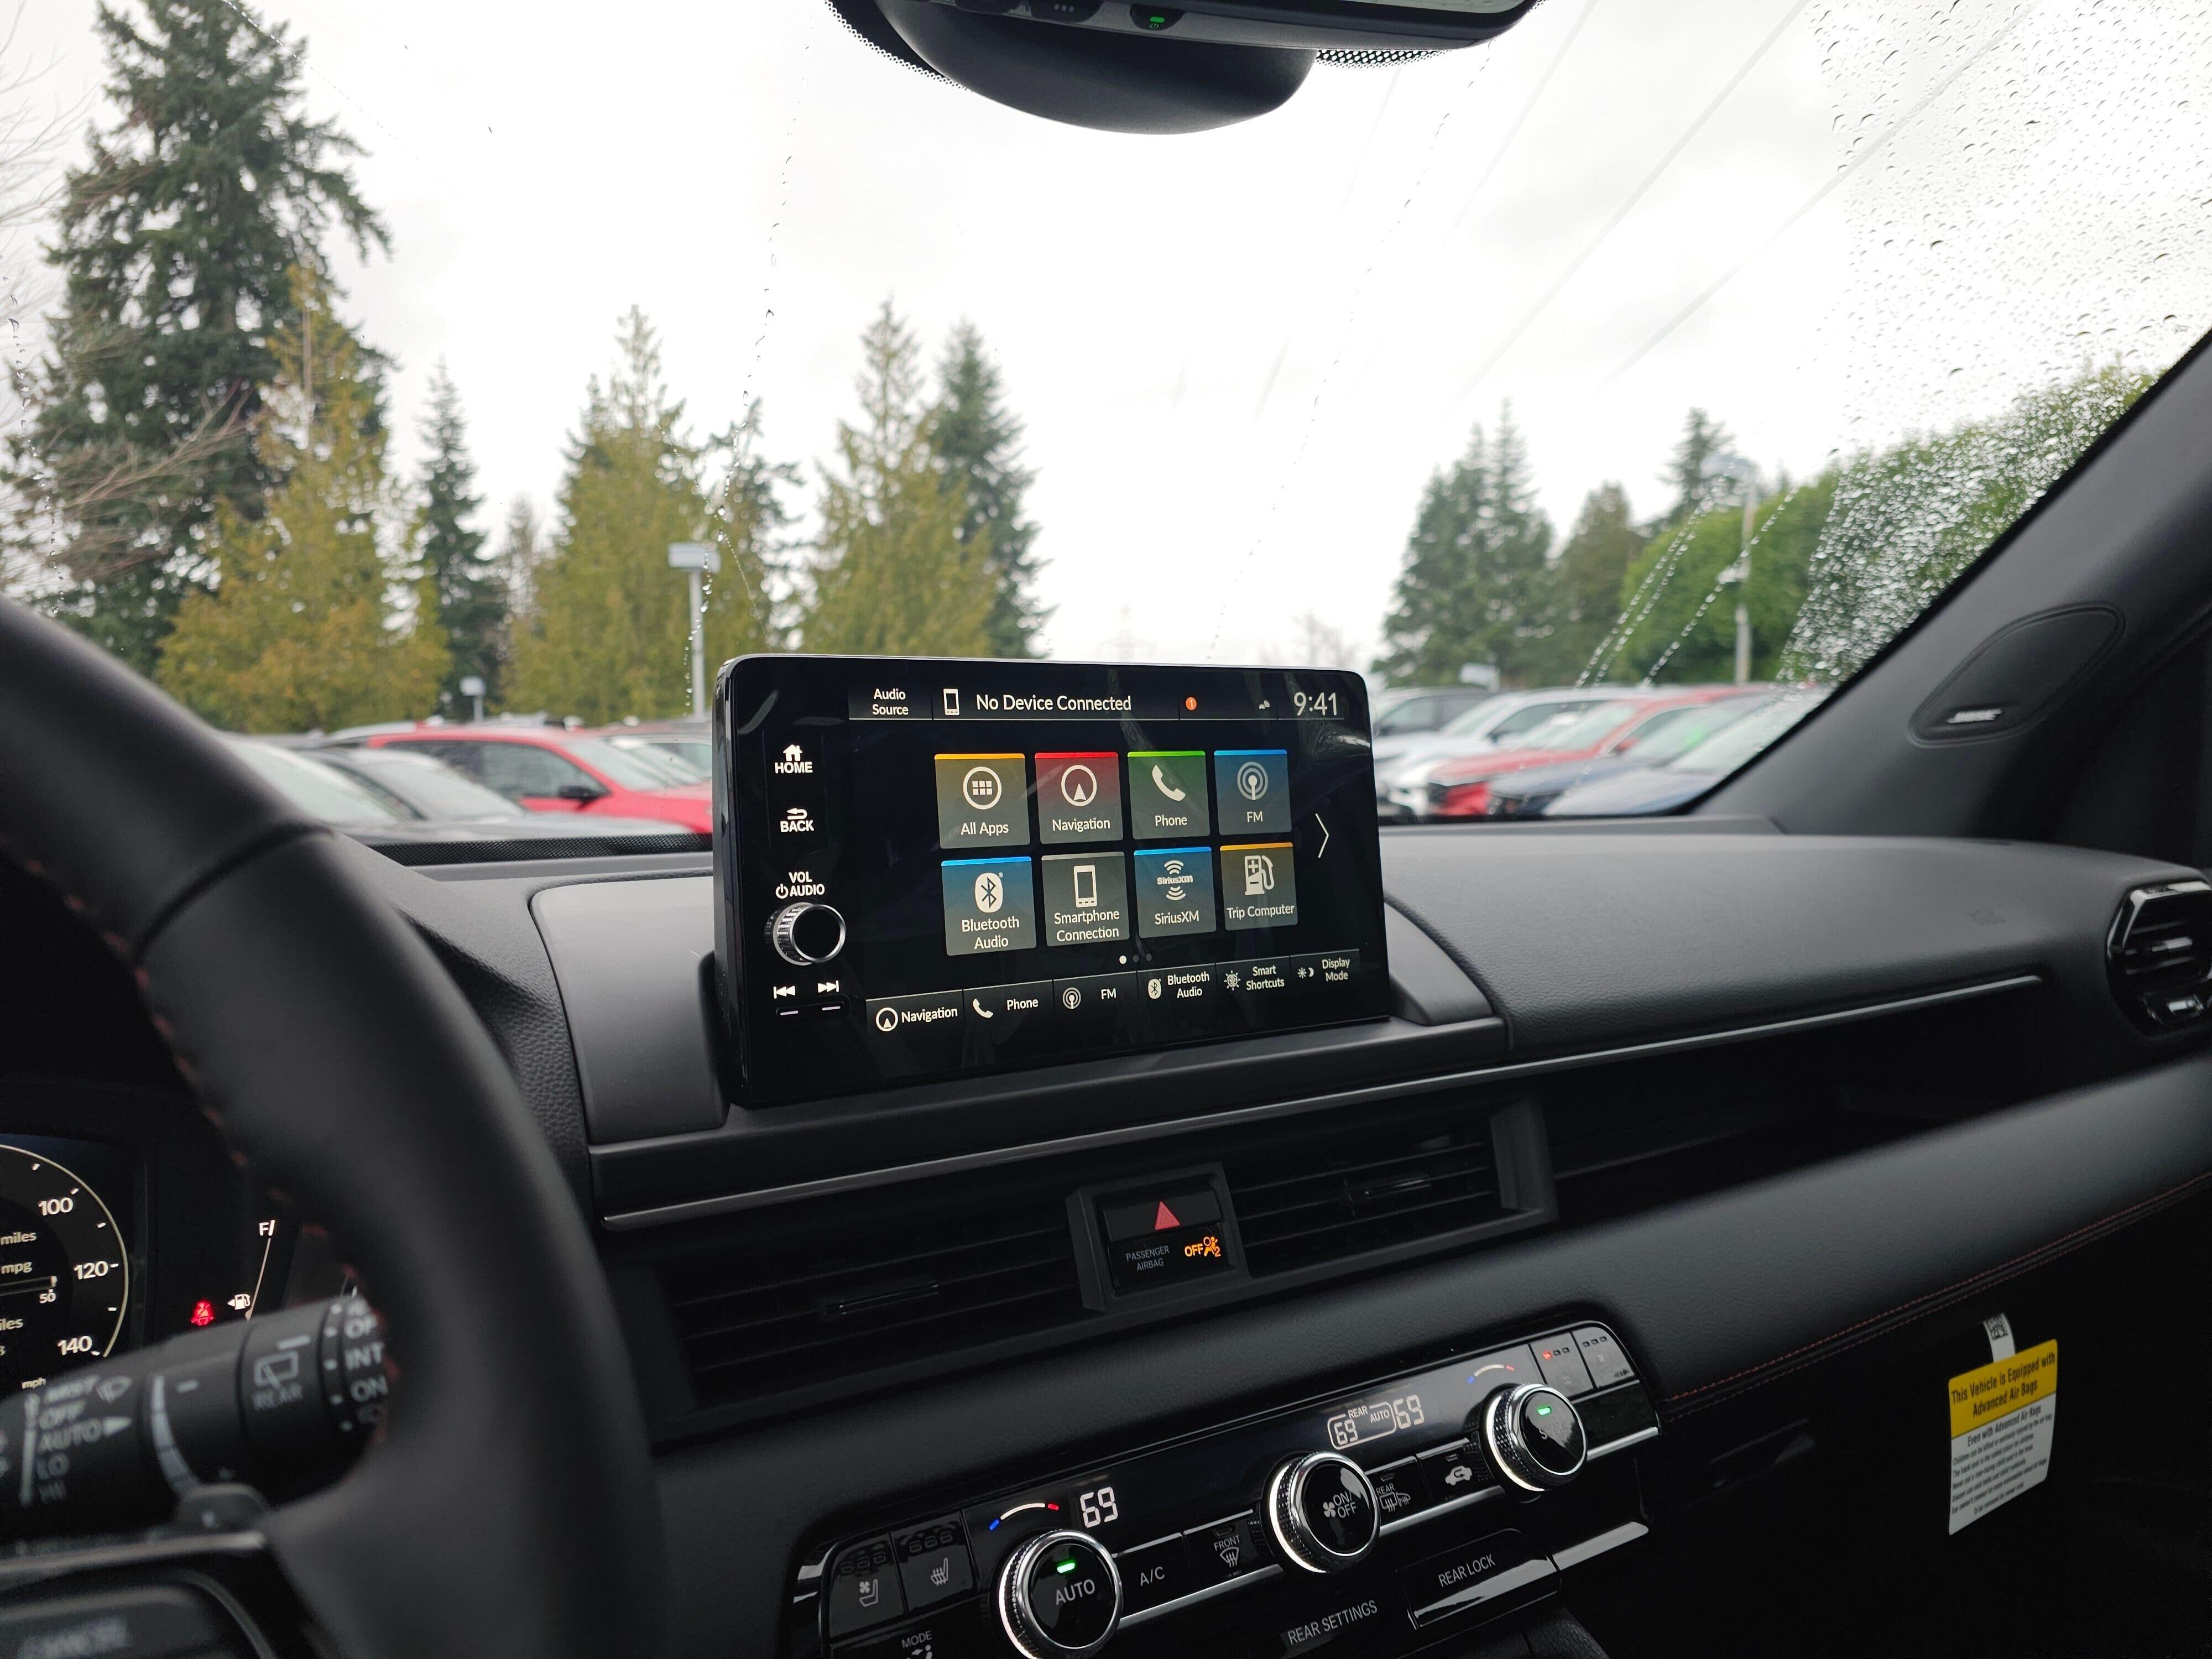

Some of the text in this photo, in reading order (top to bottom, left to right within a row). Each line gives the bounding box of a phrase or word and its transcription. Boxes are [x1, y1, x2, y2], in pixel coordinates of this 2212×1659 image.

[873, 688, 906, 700] Audio
[872, 704, 909, 716] Source
[976, 695, 1132, 712] No Device Connected
[1293, 691, 1338, 716] 9:41
[775, 761, 813, 774] HOME
[1052, 817, 1111, 832] Navigation
[1155, 815, 1188, 827] Phone
[1246, 811, 1264, 823] FM
[780, 820, 815, 832] BACK
[961, 822, 1010, 836] All Apps
[789, 872, 813, 883] VOL
[789, 884, 826, 897] AUDIO
[1054, 909, 1120, 926] Smartphone
[1155, 910, 1199, 925] SiriusXM
[1227, 904, 1295, 920] Trip Computer
[961, 916, 1020, 933] Bluetooth
[1056, 926, 1119, 942] Connection
[974, 936, 1009, 950] Audio
[1253, 966, 1277, 977] Smart
[1322, 958, 1350, 971] Display
[1167, 972, 1210, 986] Bluetooth
[1326, 971, 1349, 982] Mode
[1246, 978, 1285, 992] Shortcuts
[1100, 989, 1117, 1000] FM
[1177, 987, 1203, 999] Audio
[1006, 997, 1039, 1011] Phone
[901, 1006, 958, 1023] Navigation
[38, 1197, 73, 1216] 100
[259, 1222, 269, 1236] F
[0, 1232, 37, 1245] miles
[1125, 1245, 1170, 1262] PASSENGER
[1185, 1243, 1203, 1257] OFF
[0, 1261, 33, 1274] mpg
[74, 1260, 109, 1280] 120
[1136, 1258, 1164, 1272] AIRBAG
[39, 1292, 56, 1304] 50
[58, 1335, 92, 1355] 140
[1952, 1387, 1968, 1405] This
[1970, 1375, 1997, 1398] Vehicle
[2007, 1358, 2039, 1383] Equipped
[2041, 1352, 2056, 1368] with
[1973, 1380, 2038, 1418] Advanced Air Bags
[1348, 1405, 1390, 1423] REAR AUTO
[1392, 1394, 1425, 1430] 69
[1333, 1419, 1359, 1446] 69
[1376, 1483, 1396, 1495] REAR
[1080, 1485, 1119, 1528] 69
[1337, 1501, 1357, 1518] OFF
[1213, 1535, 1240, 1552] FRONT
[1140, 1567, 1166, 1586] A/C
[1438, 1554, 1496, 1588] REAR LOCK
[1055, 1579, 1096, 1606] AUTO
[1287, 1600, 1378, 1645] REAR SETTINGS
[901, 1630, 933, 1649] MODE
